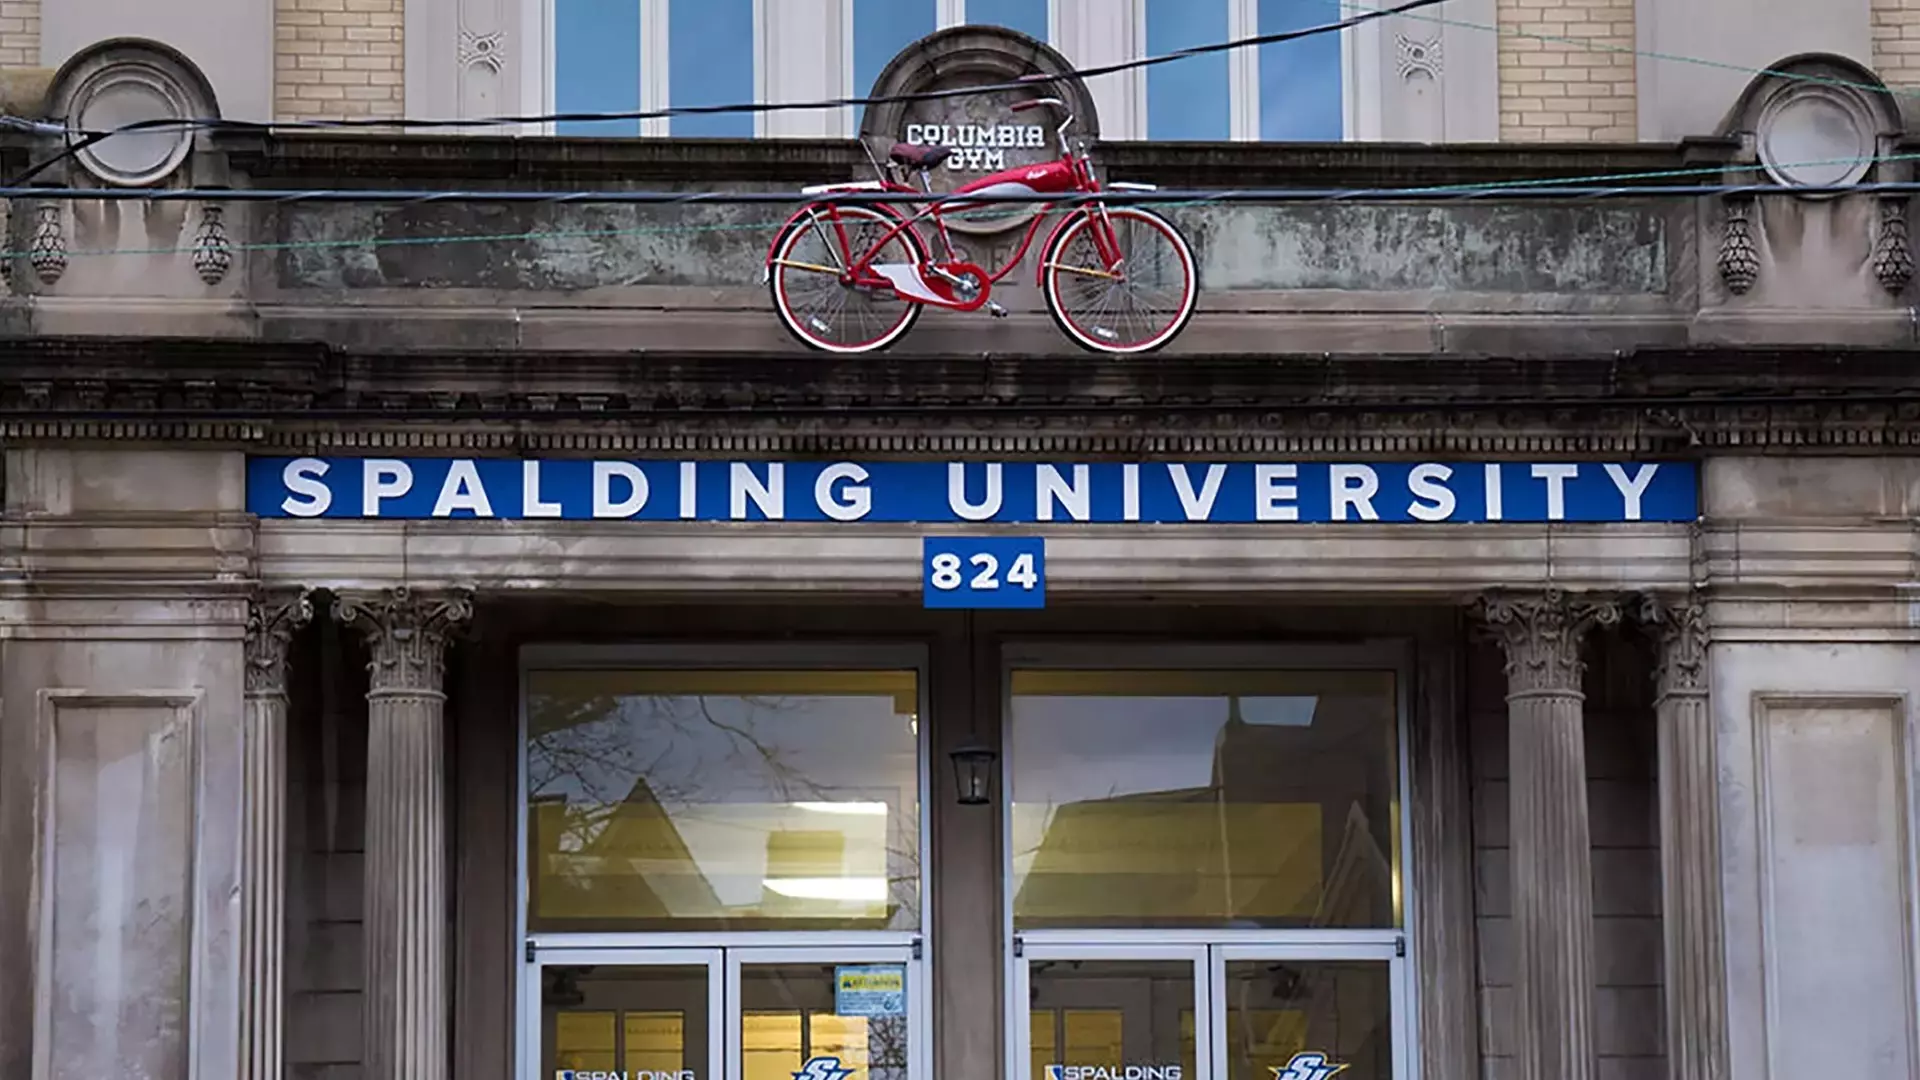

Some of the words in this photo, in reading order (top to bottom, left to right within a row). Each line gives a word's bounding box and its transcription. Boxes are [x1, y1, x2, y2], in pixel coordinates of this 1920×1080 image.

[907, 124, 1046, 147] COLUMBIA
[947, 148, 1006, 170] GYM
[281, 458, 873, 522] SPALDING
[948, 463, 1659, 522] UNIVERSITY
[931, 553, 1039, 590] 824
[1064, 1066, 1182, 1080] SPALDING
